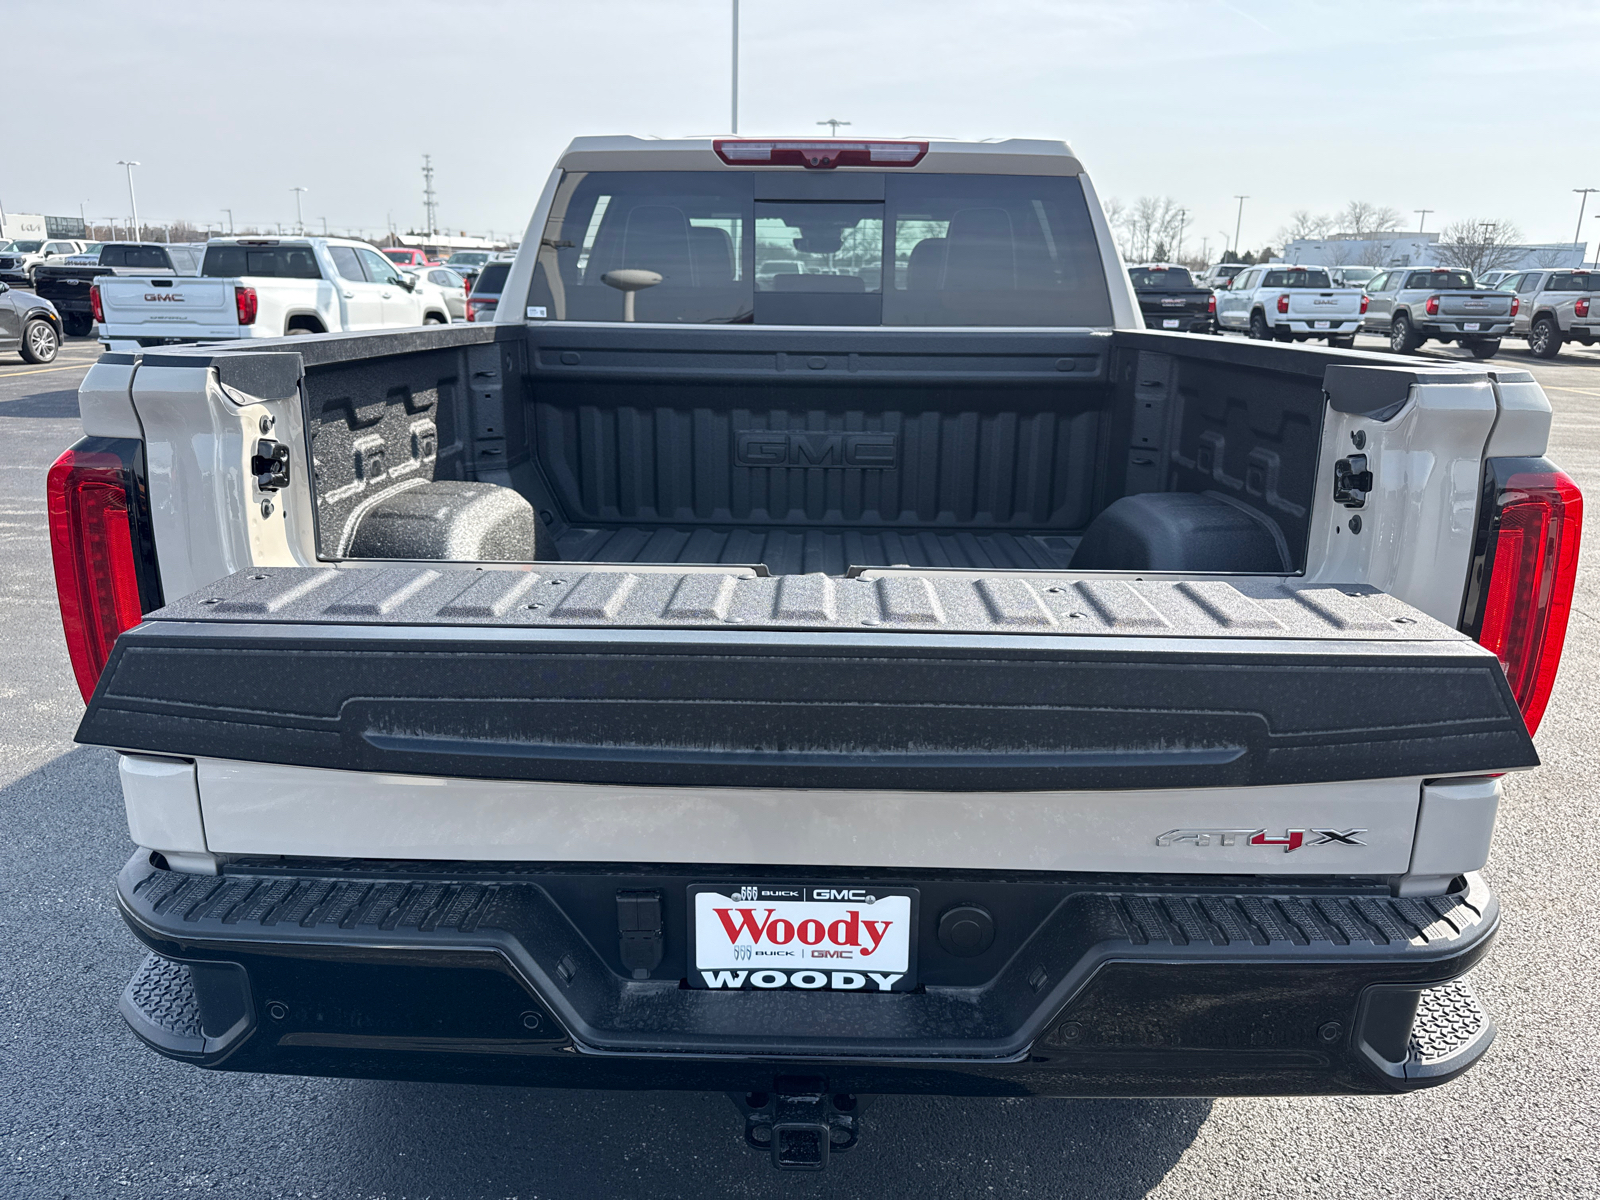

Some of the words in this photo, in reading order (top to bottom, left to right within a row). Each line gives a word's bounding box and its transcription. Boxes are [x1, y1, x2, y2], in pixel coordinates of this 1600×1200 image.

[144, 293, 185, 302] GMC
[737, 434, 895, 466] GMC
[1155, 828, 1368, 853] AT4X
[812, 889, 866, 901] GMC
[712, 908, 893, 956] Woody
[811, 949, 853, 959] GMC
[701, 970, 904, 991] WOODY
